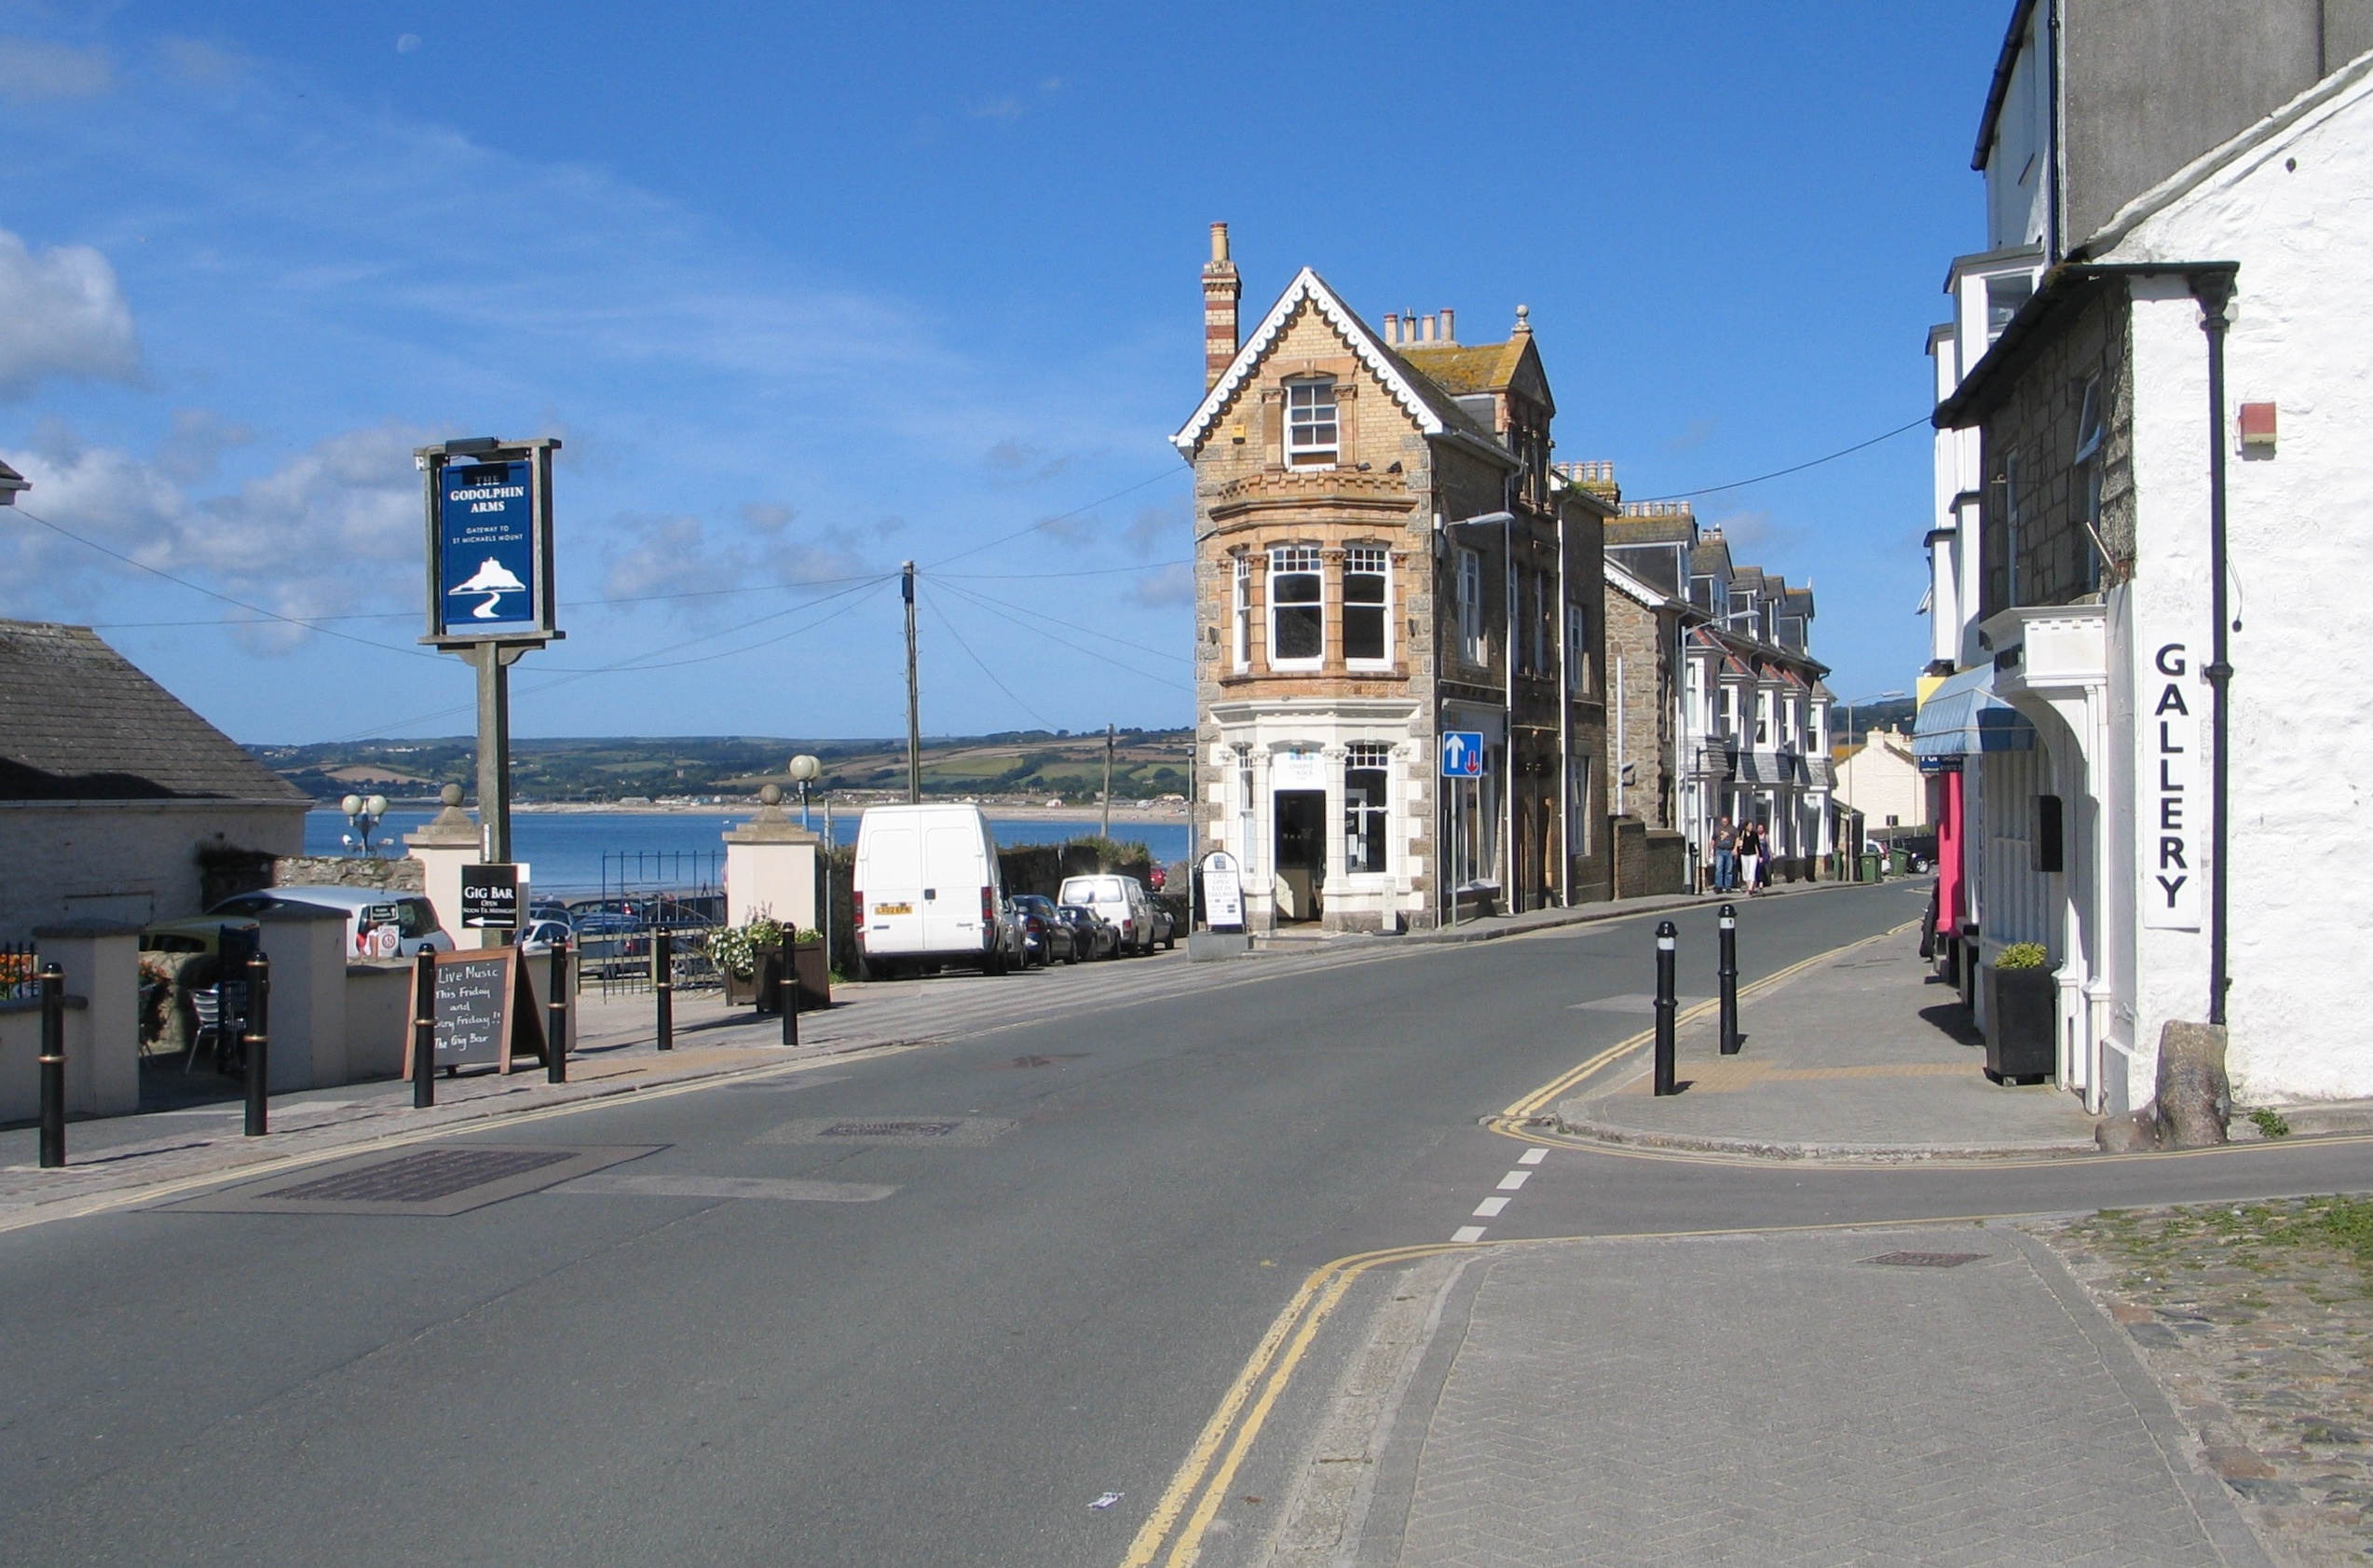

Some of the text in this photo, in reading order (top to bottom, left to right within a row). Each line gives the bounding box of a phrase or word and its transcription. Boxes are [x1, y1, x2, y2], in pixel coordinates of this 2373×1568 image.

[474, 474, 500, 486] THE
[450, 486, 525, 501] GODOLPHIN
[471, 501, 505, 513] ARMS
[466, 525, 498, 535] GATEWAY
[462, 535, 497, 543] MICHAELS
[498, 533, 524, 541] MOUNT
[2154, 643, 2189, 908] GALLERY
[464, 886, 514, 899] GIG BAR
[480, 899, 498, 907] OPEN
[438, 962, 499, 984] Live Music
[435, 986, 491, 1000] This Friday
[449, 1002, 471, 1011] and
[457, 1014, 490, 1029] Friday
[434, 1032, 489, 1052] The Gig Bar
